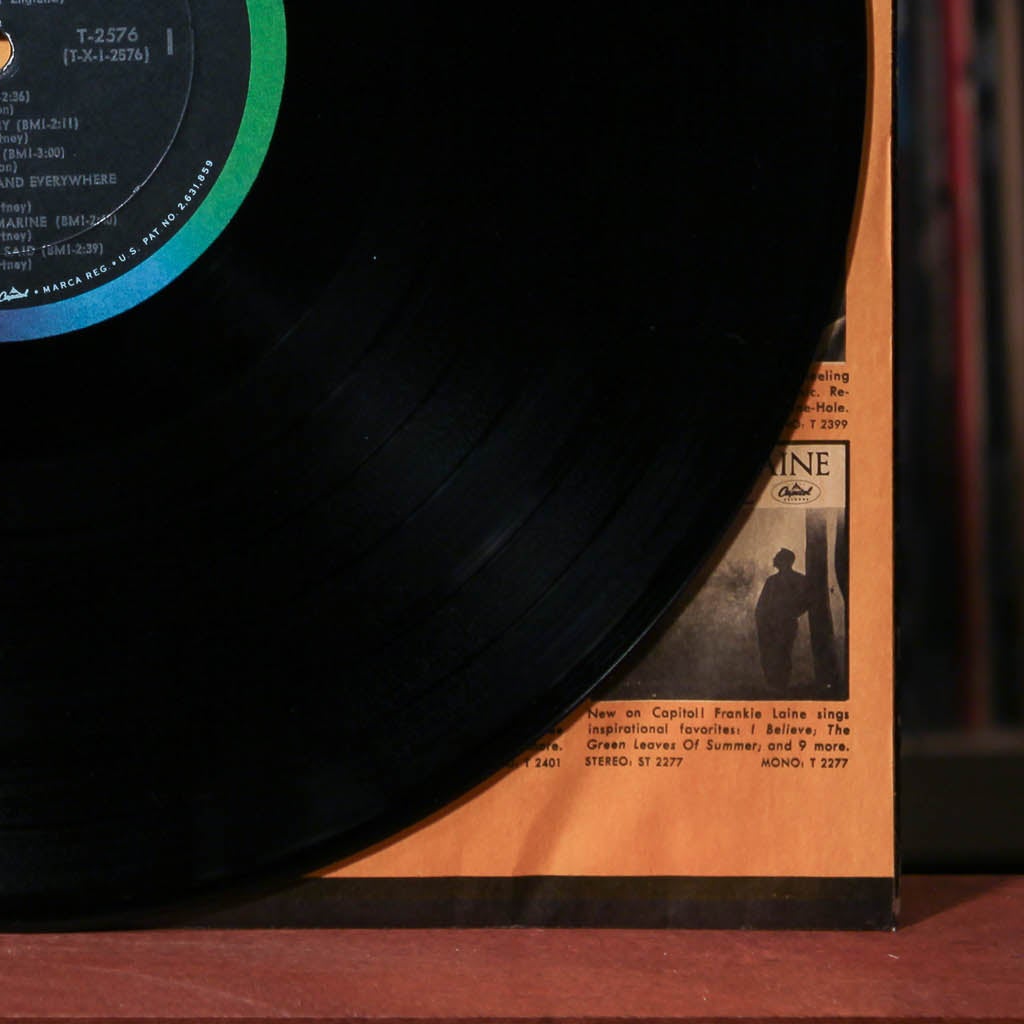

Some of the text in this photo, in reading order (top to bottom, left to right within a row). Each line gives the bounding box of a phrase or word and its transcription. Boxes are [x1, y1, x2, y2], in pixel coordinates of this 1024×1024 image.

[76, 27, 139, 44] T-2576
[3, 146, 65, 161] (BMI-3:00)
[30, 173, 117, 188] EVERYWHERE
[41, 243, 104, 257] (BMI-2:39)
[42, 276, 83, 294] MARCA
[830, 386, 849, 397] Re-
[810, 420, 817, 429] T
[820, 420, 848, 429] 2399
[587, 709, 616, 719] New
[626, 710, 641, 718] on
[714, 708, 762, 719] Frankie
[772, 708, 807, 719] Laine
[817, 708, 849, 722] sings
[588, 723, 668, 736] inspirational
[680, 724, 741, 735] favorites:
[766, 724, 817, 736] Believe;
[828, 725, 850, 735] The
[586, 739, 850, 752] Green Leaves Of Summer; and 9 more.
[535, 757, 561, 767] 2401
[584, 756, 683, 767] STEREO: ST 2277
[761, 758, 849, 768] MONO: T 2277
